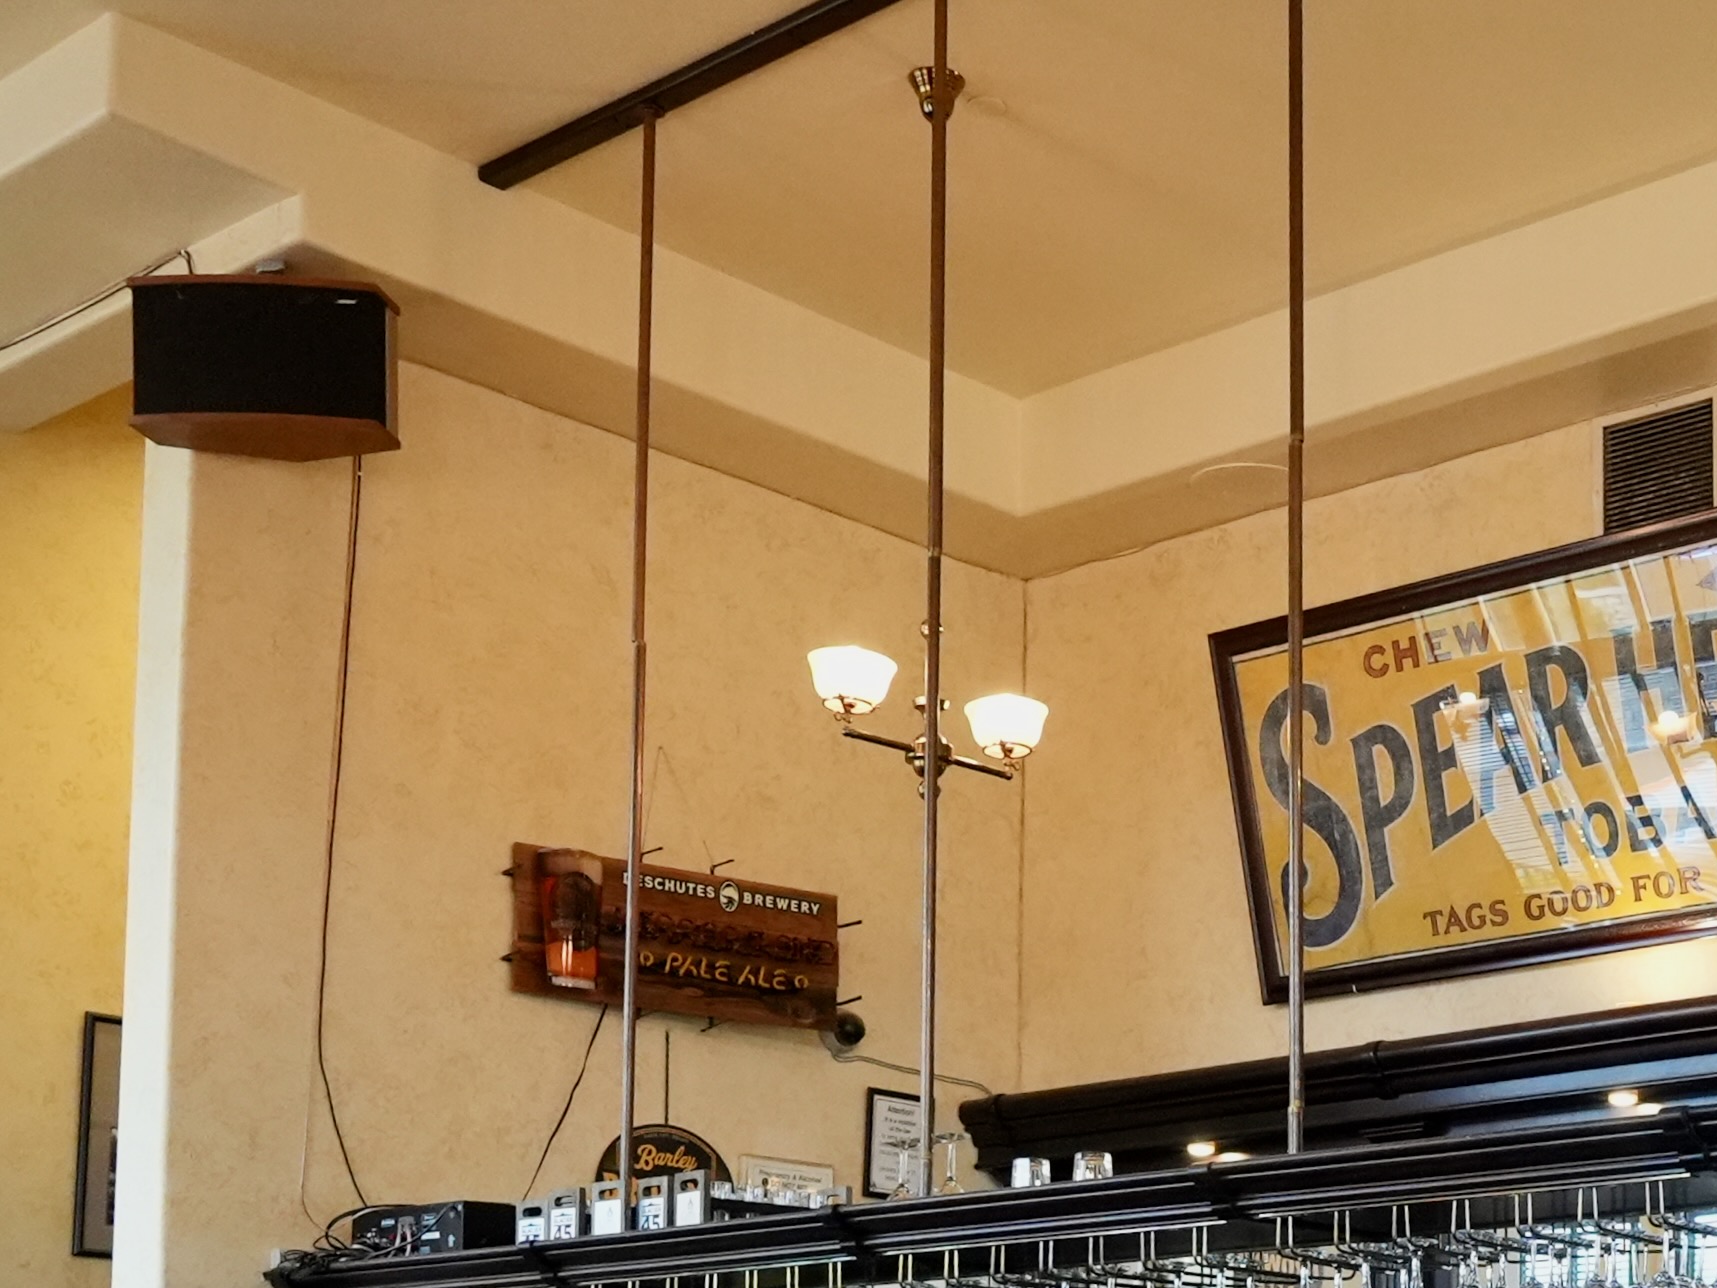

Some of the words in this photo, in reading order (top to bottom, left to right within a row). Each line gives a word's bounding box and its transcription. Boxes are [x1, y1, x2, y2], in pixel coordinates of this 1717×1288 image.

[1362, 619, 1490, 679] CHEW
[742, 891, 820, 916] BREWERY
[1423, 899, 1509, 937] TAGS
[1523, 882, 1615, 922] GOOD
[1630, 865, 1703, 902] FOR
[664, 951, 731, 982] PALE
[737, 965, 787, 990] ALE
[634, 1144, 698, 1172] Barley
